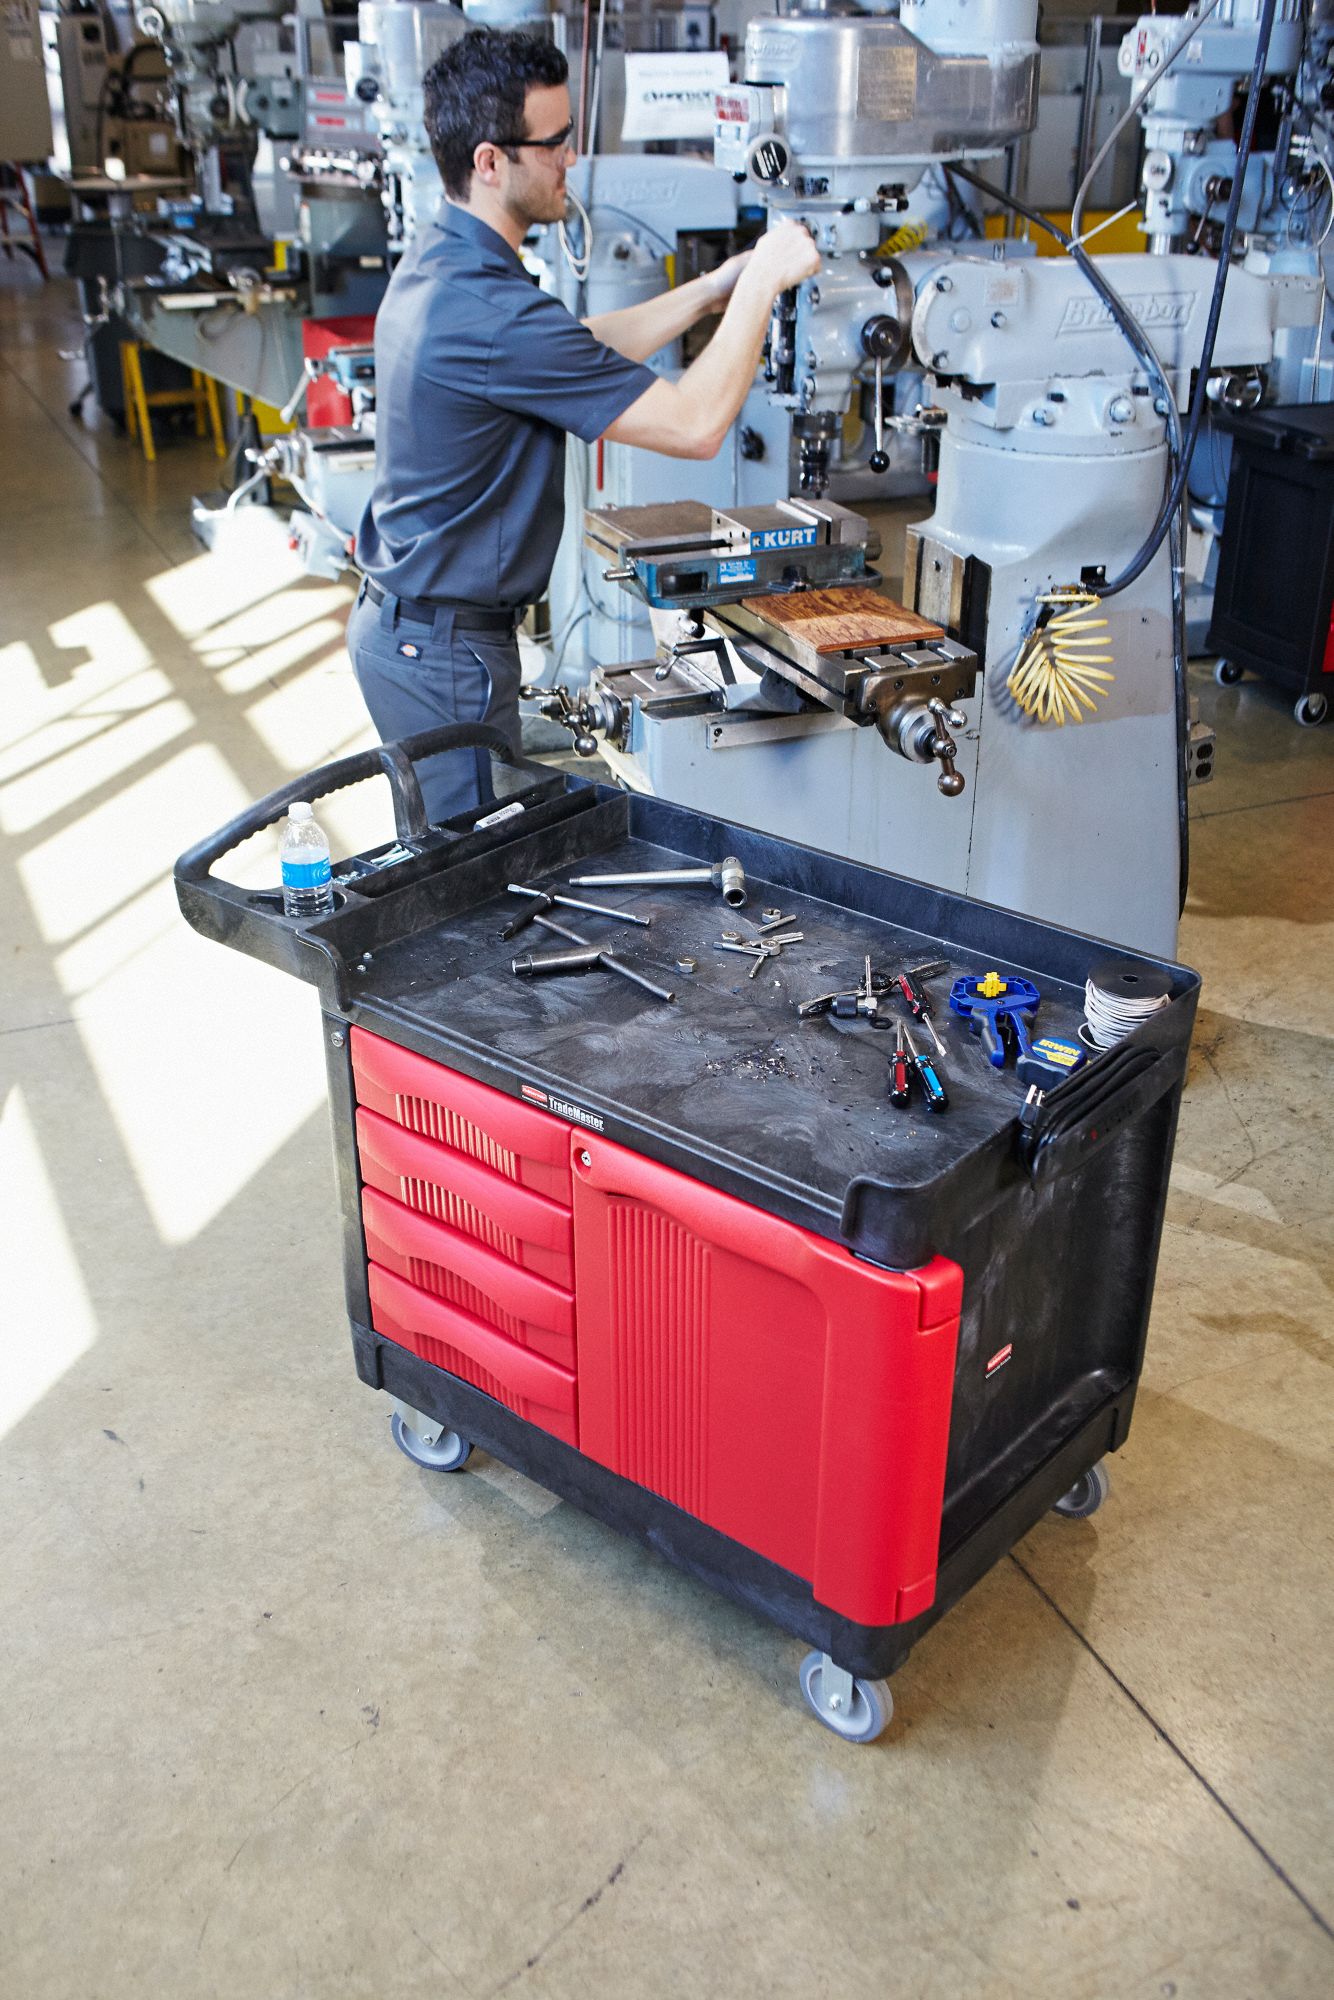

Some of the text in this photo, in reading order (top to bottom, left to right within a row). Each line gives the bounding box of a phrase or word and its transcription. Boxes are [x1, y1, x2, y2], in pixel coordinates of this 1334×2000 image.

[764, 527, 815, 548] KURT
[1038, 1039, 1081, 1056] IRWIN
[549, 1097, 603, 1129] TradeMaster
